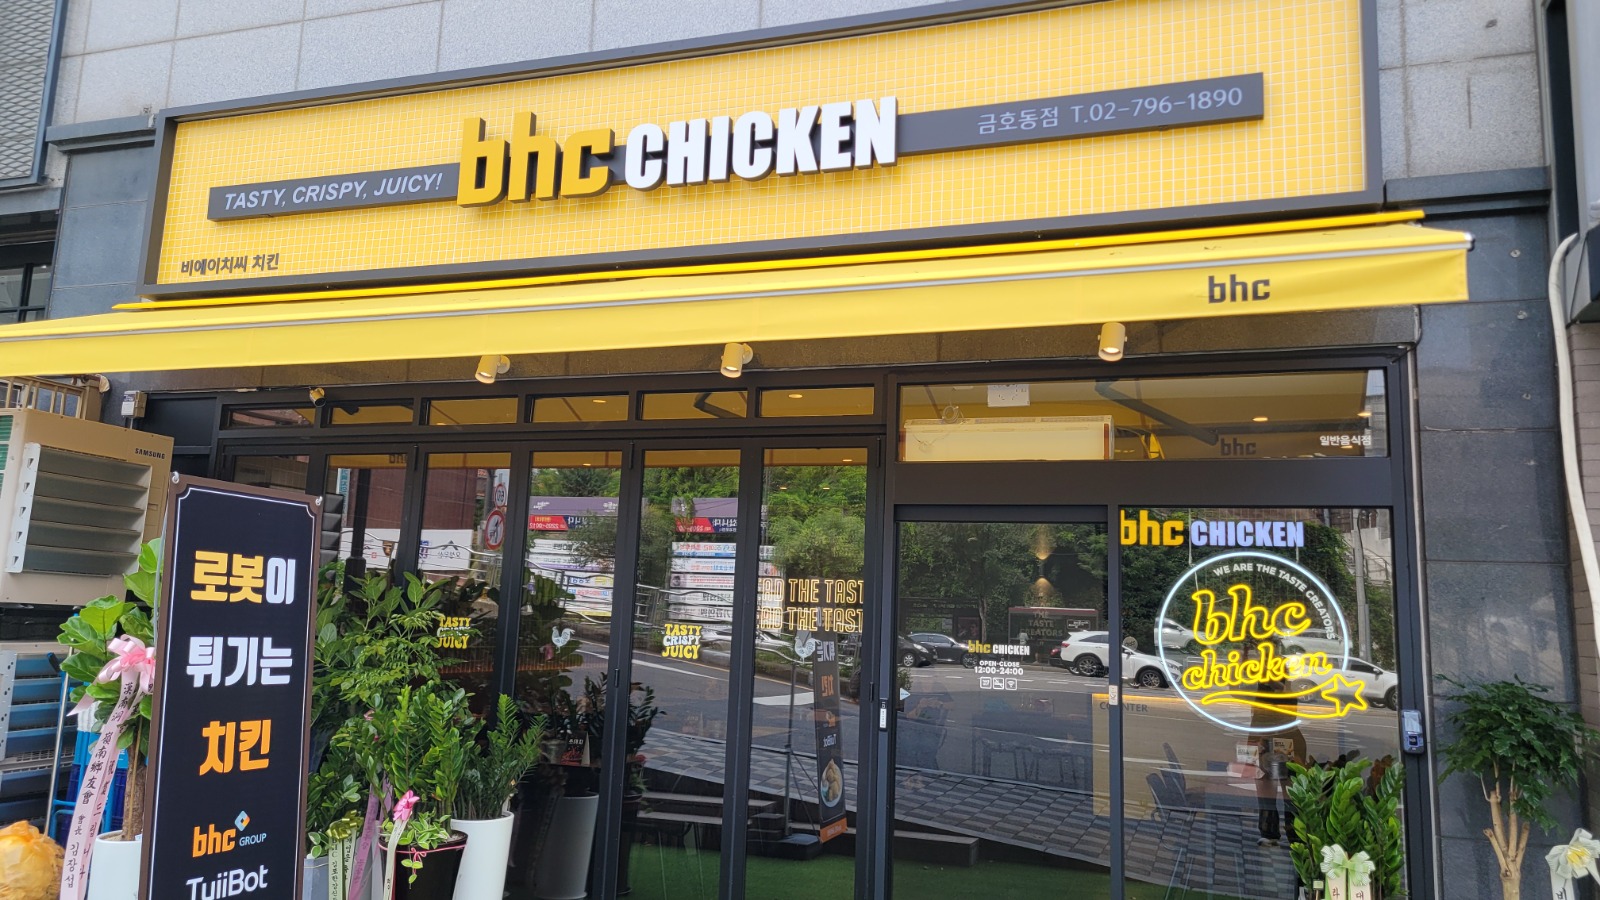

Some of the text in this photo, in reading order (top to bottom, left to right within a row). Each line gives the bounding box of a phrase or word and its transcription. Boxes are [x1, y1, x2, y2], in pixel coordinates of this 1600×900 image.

[977, 87, 1243, 135] 금호동점 T.02-796-1890
[457, 95, 898, 208] bhc CHICKEN
[224, 172, 443, 211] TASTY, CRISPY, JUICY!
[181, 253, 279, 275] 비에이치씨 치킨
[1208, 274, 1270, 304] bhc
[1220, 437, 1256, 456] bhc
[1319, 434, 1371, 446] 일반음식점
[135, 447, 166, 459] SAMSUNG
[1120, 509, 1304, 547] bhc CHICKEN
[190, 550, 296, 605] 로봇이
[788, 579, 820, 603] THE
[1213, 563, 1335, 640] WE ARE THE TASTE CREATORS
[439, 616, 471, 628] TASTY
[787, 607, 818, 632] THE
[1028, 620, 1054, 628] TASTE
[1191, 584, 1312, 645] bhc
[662, 634, 701, 646] CRISPY
[664, 623, 702, 636] TASTY
[434, 635, 469, 649] JUICY
[661, 644, 700, 660] JUICY
[968, 640, 1030, 656] bhc CHICKEN
[186, 636, 293, 688] 튀기는
[974, 666, 1024, 676] 12:00-24:00
[1182, 642, 1332, 690] chicken
[1099, 702, 1148, 713] CONTER
[199, 719, 271, 776] 치킨
[192, 823, 267, 858] bhc GROUP
[186, 864, 269, 900] TuiiBot
